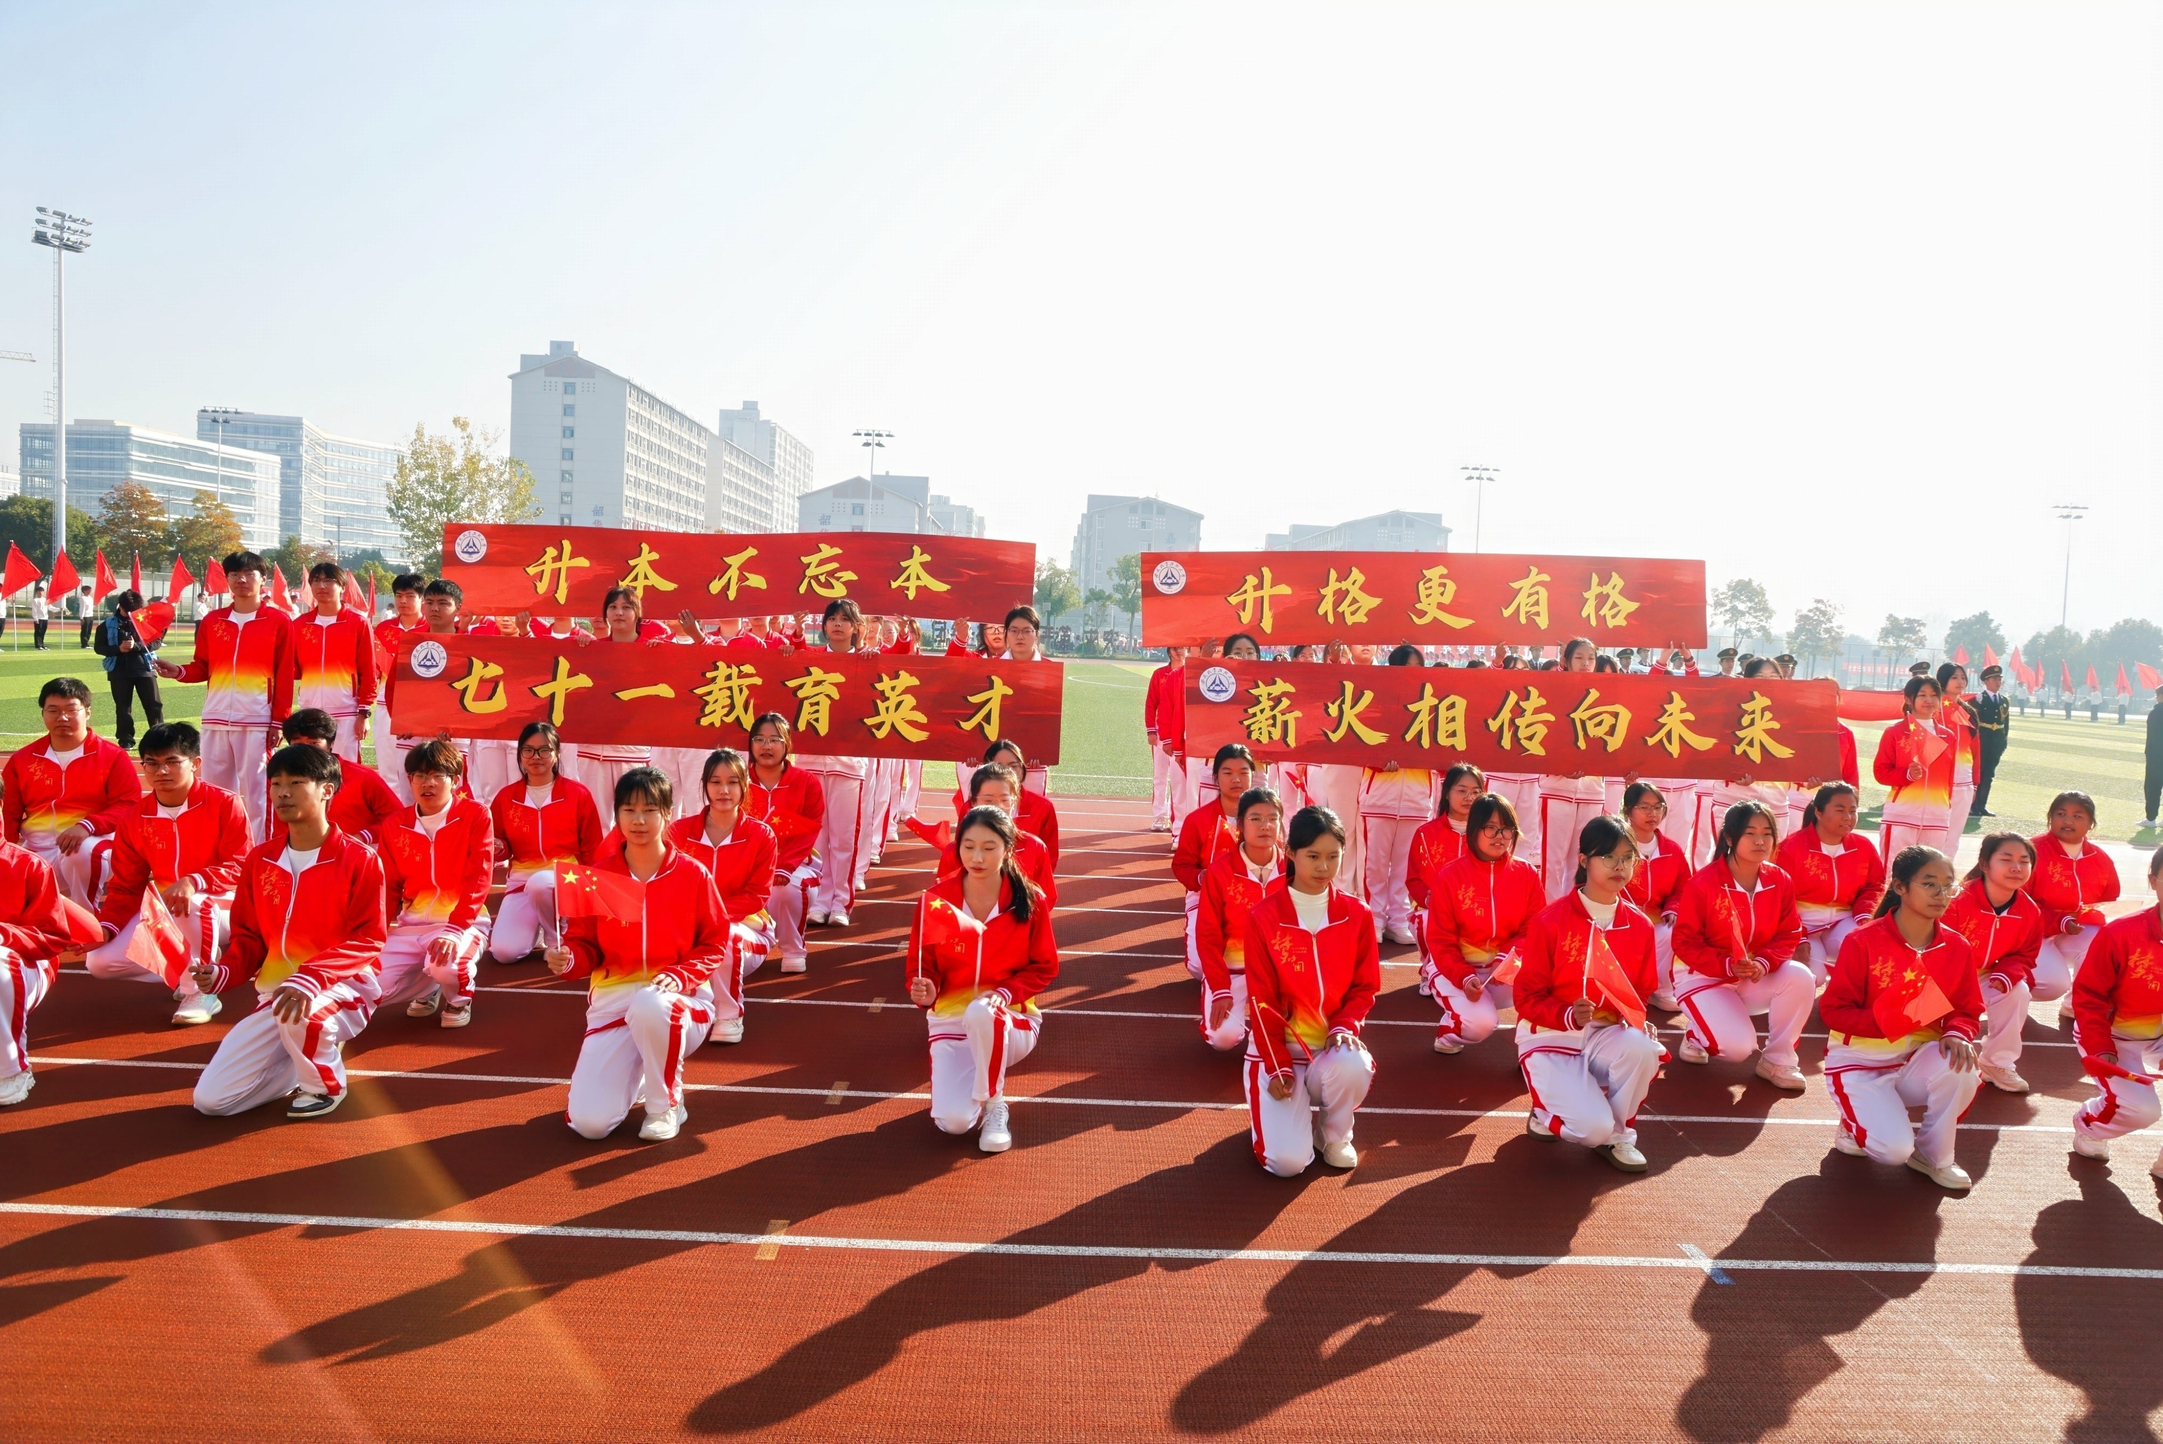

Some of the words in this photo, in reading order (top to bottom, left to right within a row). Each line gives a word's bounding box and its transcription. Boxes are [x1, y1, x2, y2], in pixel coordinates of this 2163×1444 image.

[524, 539, 951, 604] 升本不忘本
[1227, 566, 1640, 633] 升格更有格
[452, 656, 1013, 743] 七十一载育英才
[1242, 677, 1795, 763] 薪火相传向未来
